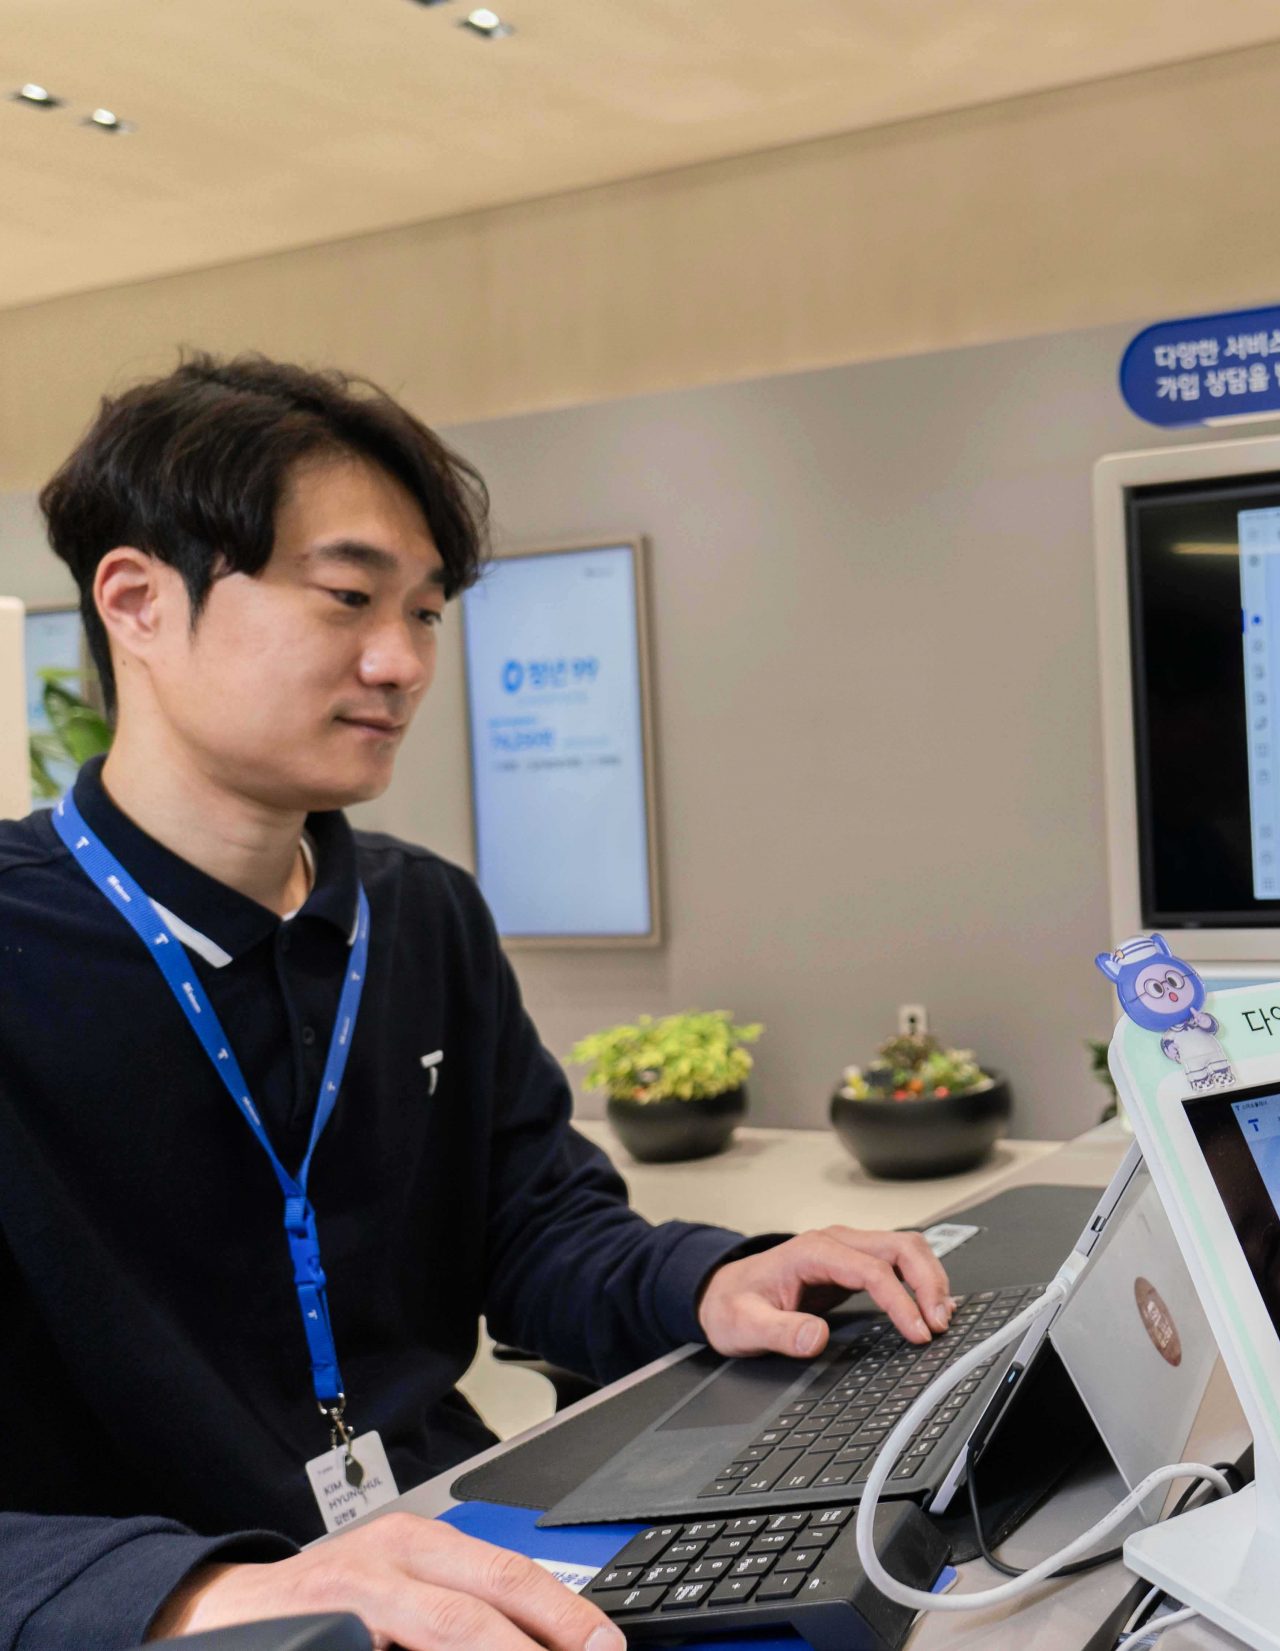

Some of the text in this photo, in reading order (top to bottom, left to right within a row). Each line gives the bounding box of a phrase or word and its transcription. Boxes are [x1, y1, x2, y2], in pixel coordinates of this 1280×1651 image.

[1154, 338, 1220, 370] 다양한
[1155, 371, 1200, 402] 가입
[1204, 363, 1269, 398] 상담을
[1248, 1118, 1259, 1132] T
[323, 1481, 343, 1496] KIM
